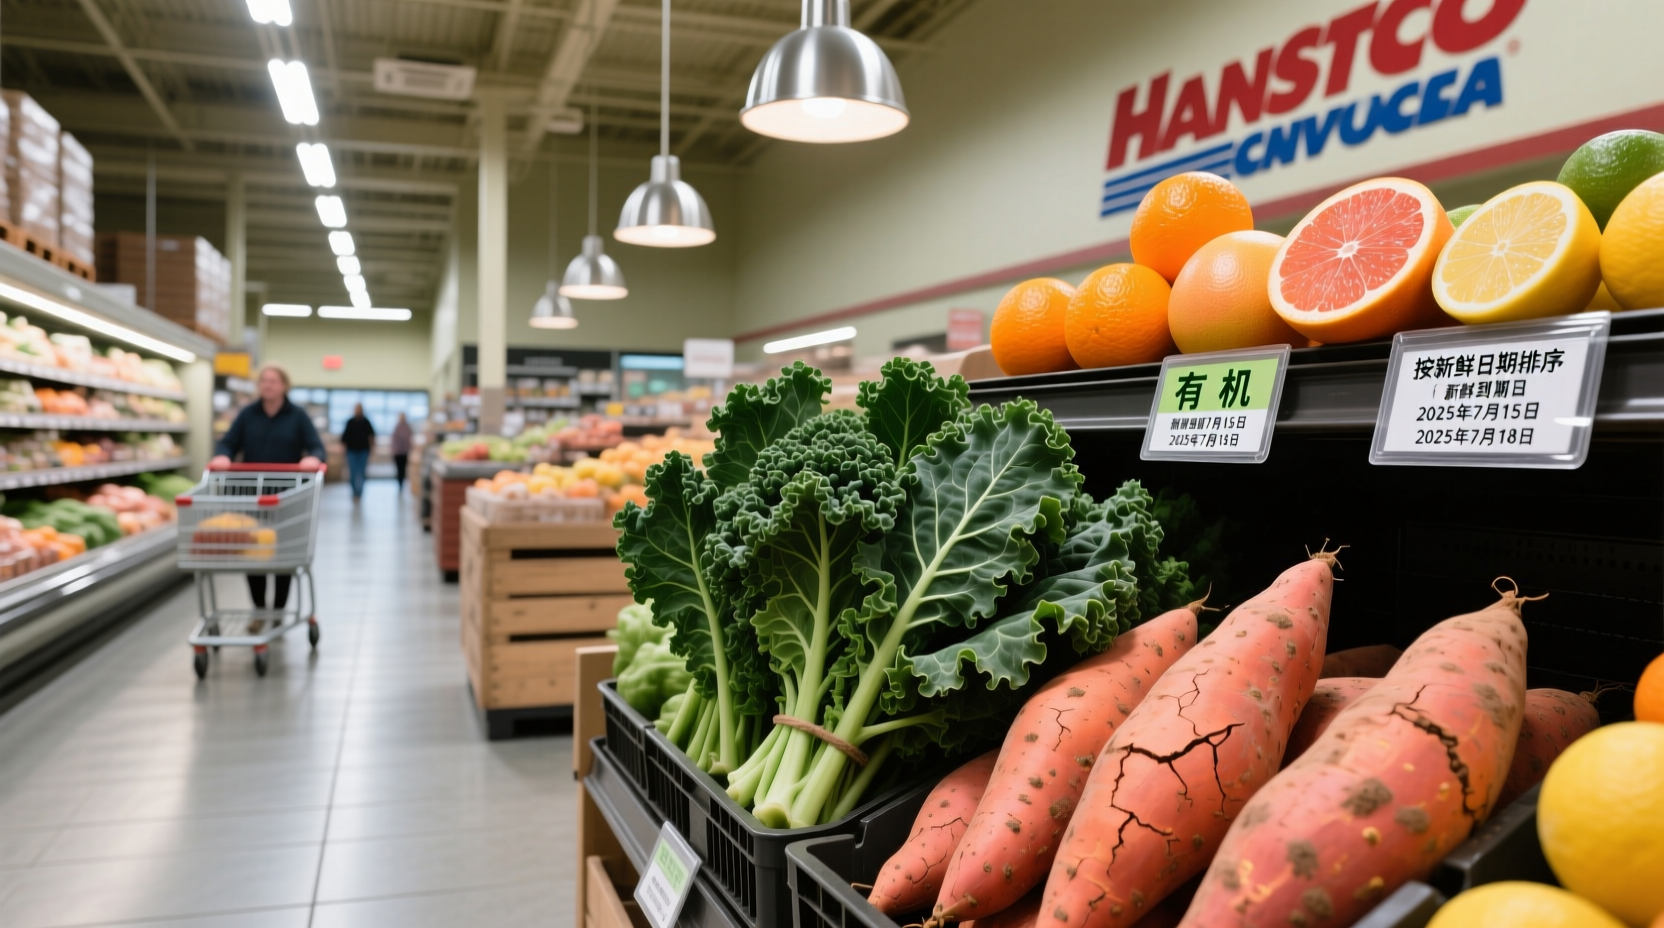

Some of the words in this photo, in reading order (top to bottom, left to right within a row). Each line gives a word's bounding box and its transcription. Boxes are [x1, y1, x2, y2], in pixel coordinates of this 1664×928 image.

[1413, 348, 1565, 380] 按新鲜日期排序
[1416, 402, 1540, 421] 2025年7月15日
[1415, 427, 1534, 446] 2025年7月18日
